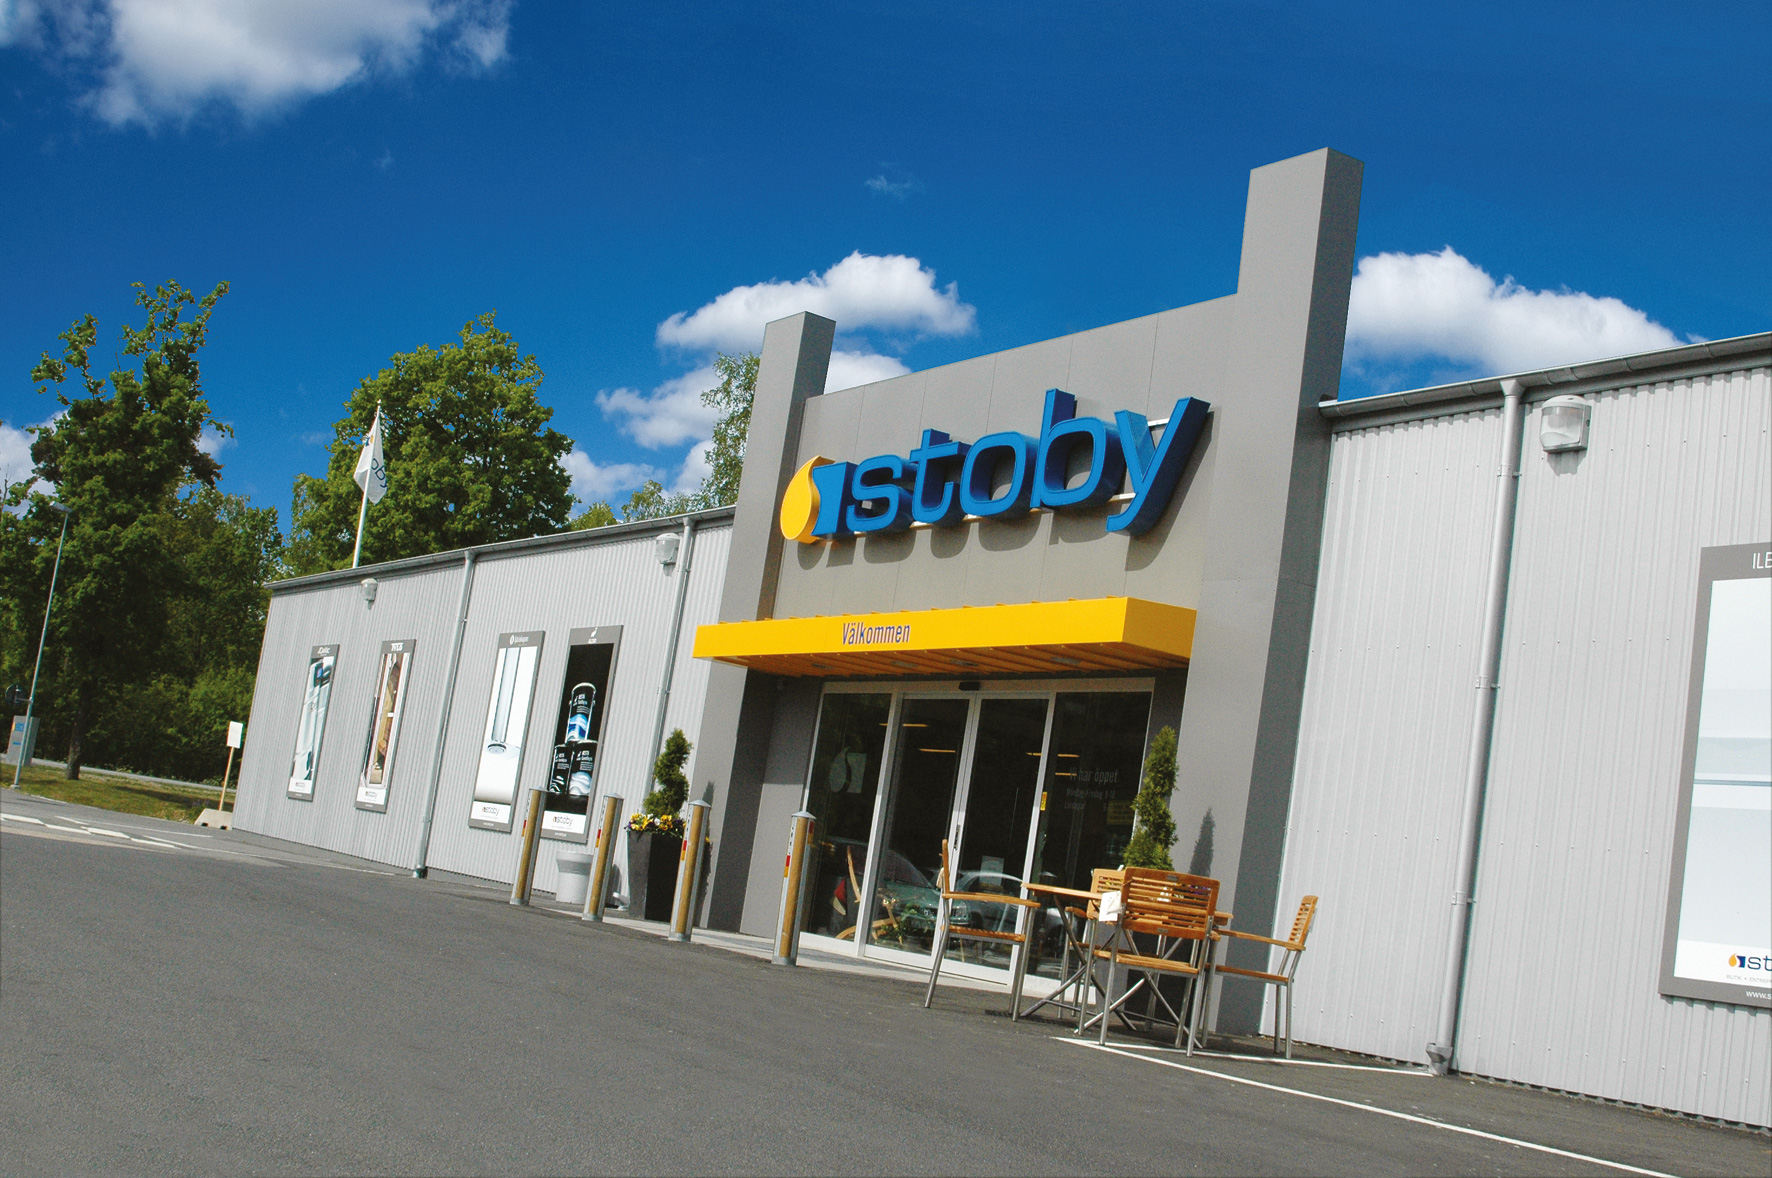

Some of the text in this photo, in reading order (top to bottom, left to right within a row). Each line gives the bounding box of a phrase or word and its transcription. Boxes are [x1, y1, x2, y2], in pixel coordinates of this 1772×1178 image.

[842, 621, 911, 645] Välkommen
[1078, 768, 1092, 782] har
[1094, 768, 1119, 785] öppet
